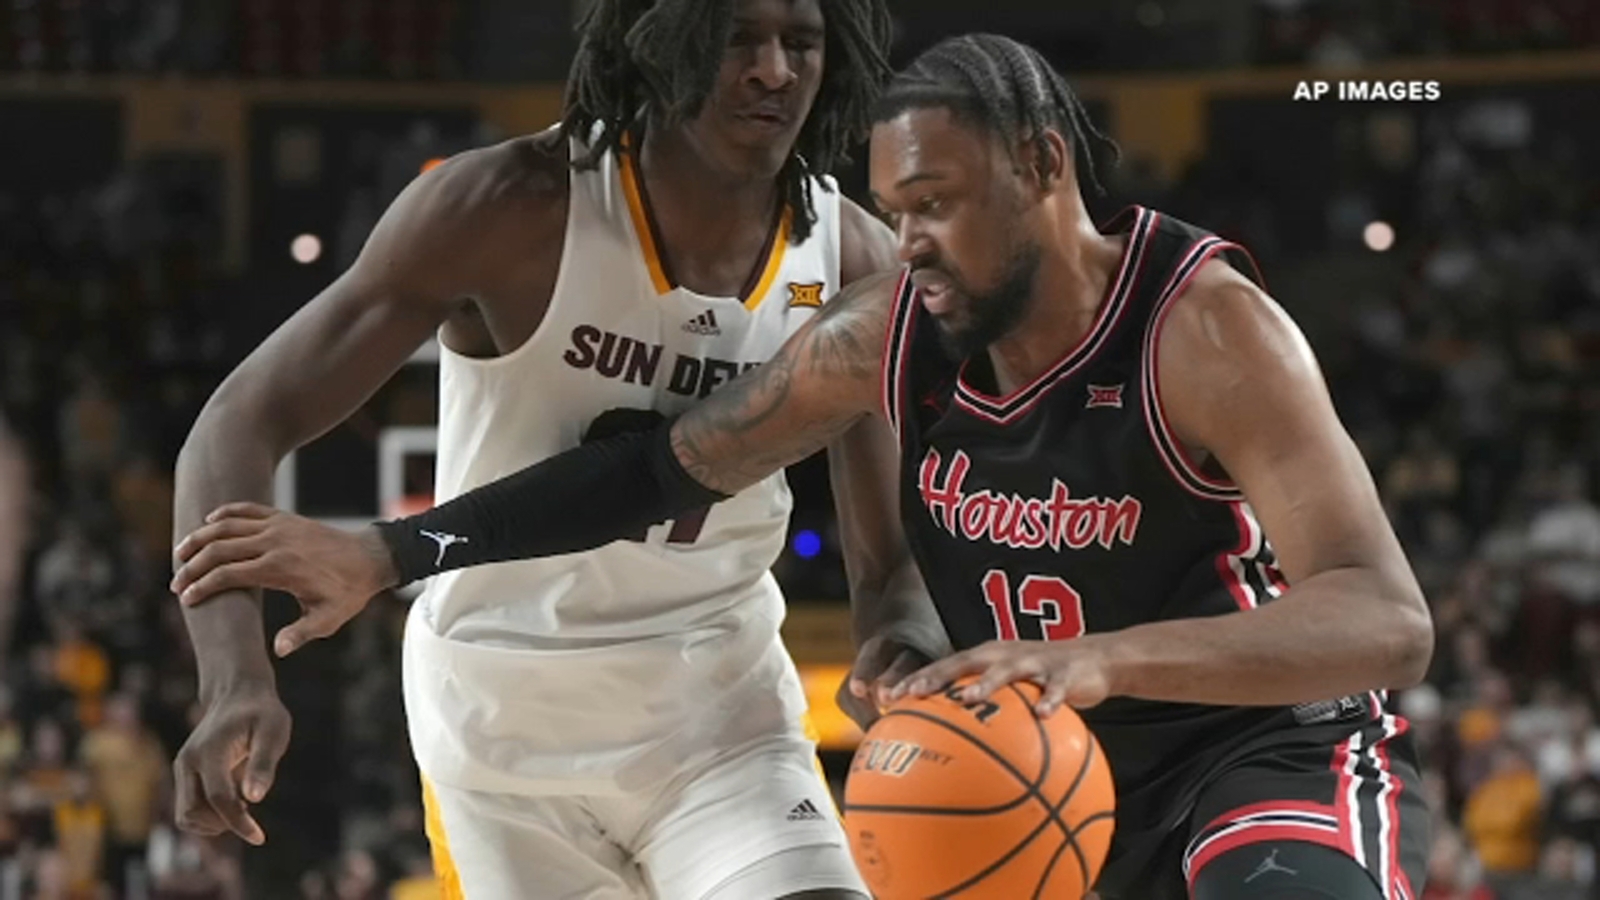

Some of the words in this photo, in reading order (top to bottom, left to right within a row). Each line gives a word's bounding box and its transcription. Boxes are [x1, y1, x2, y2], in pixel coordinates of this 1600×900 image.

[563, 325, 664, 386] SUN
[917, 445, 1141, 552] Houston
[981, 569, 1086, 641] 13
